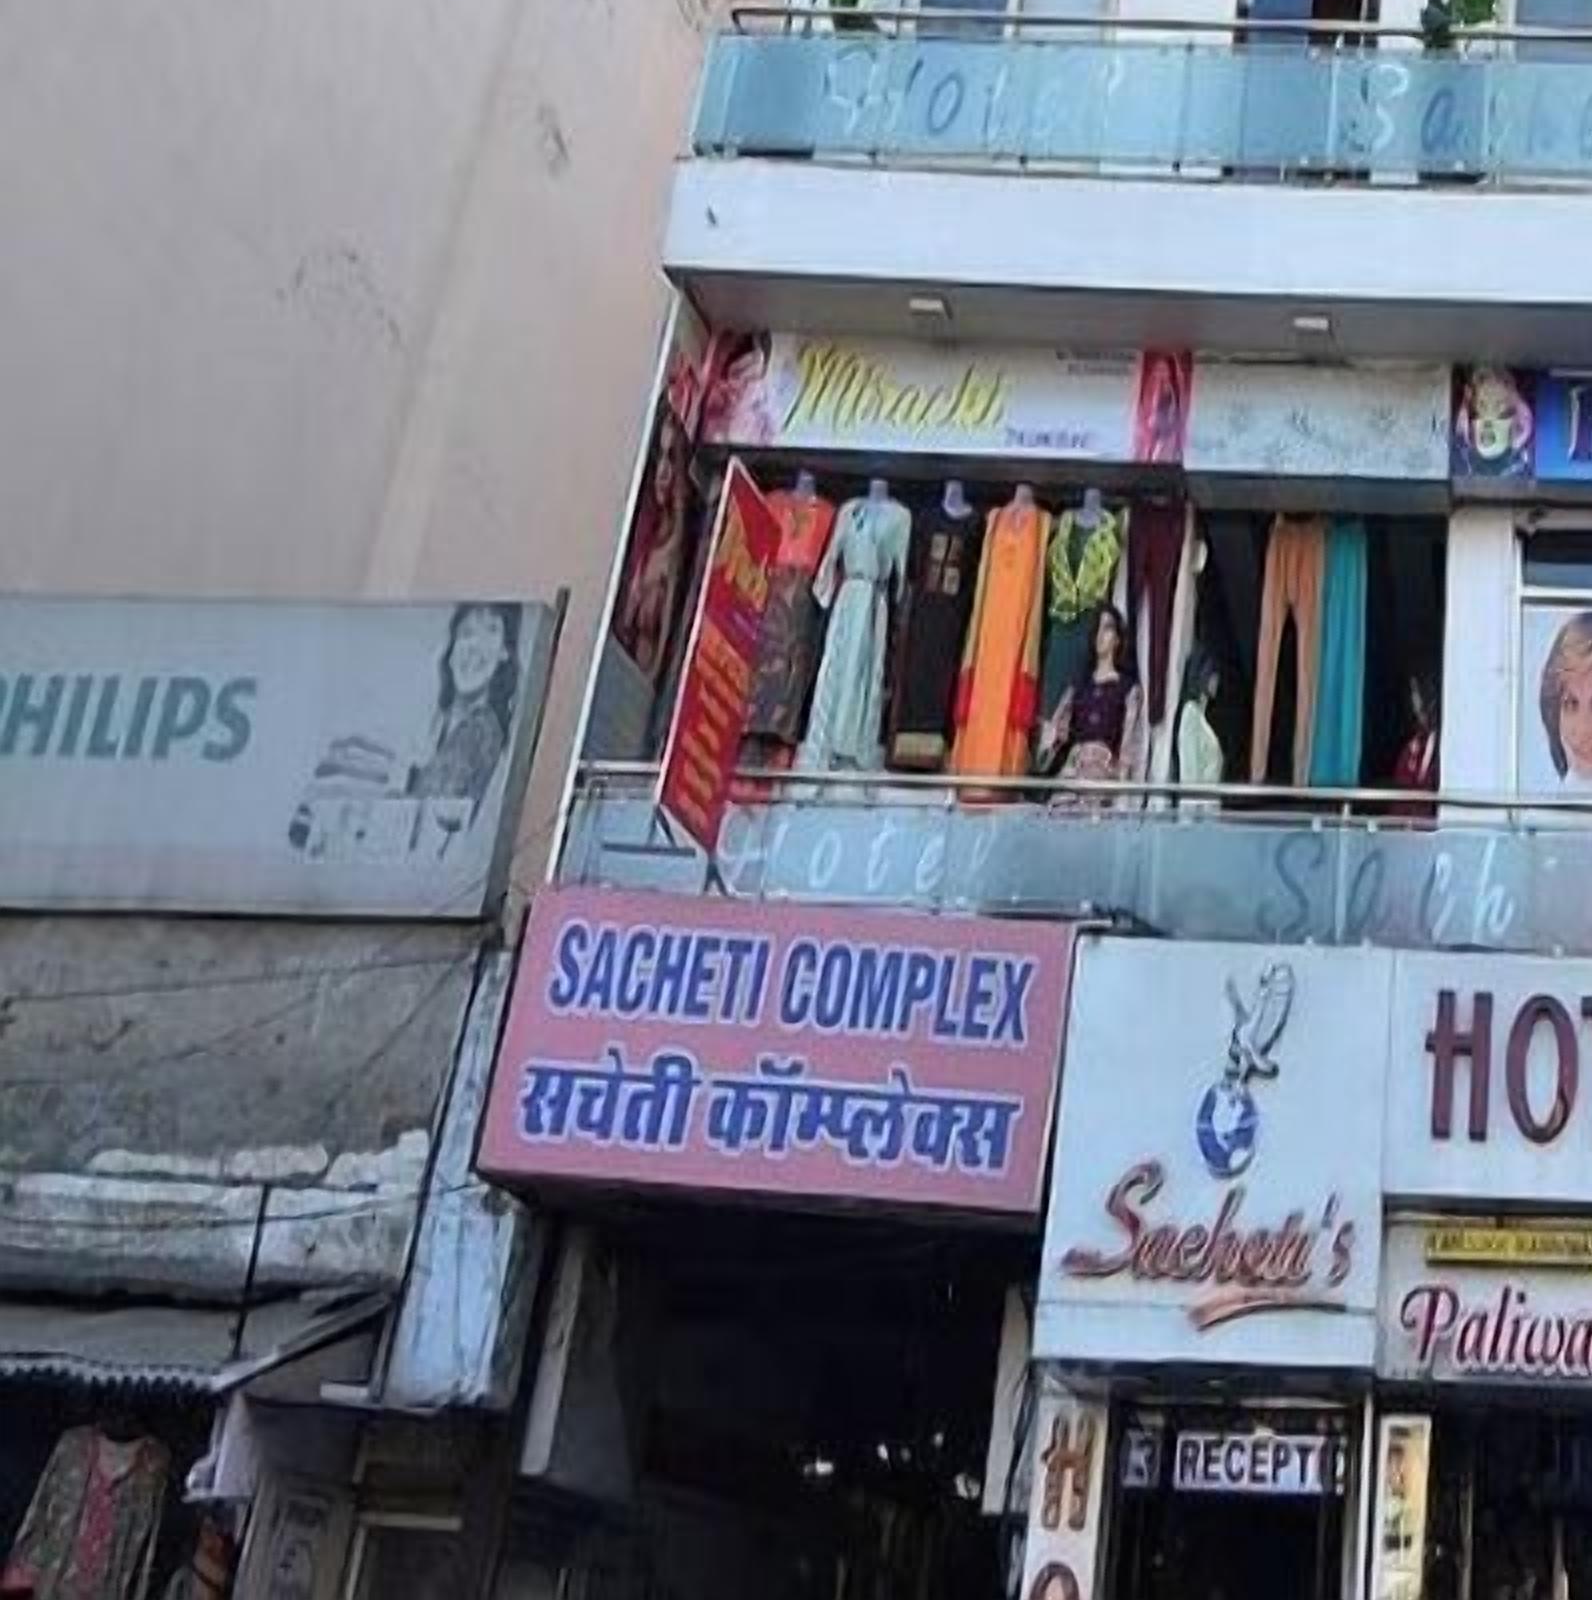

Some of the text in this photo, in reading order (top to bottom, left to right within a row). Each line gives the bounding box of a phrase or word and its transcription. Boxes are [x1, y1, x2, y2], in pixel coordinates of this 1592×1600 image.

[0, 673, 258, 761] HILIPS
[548, 923, 1034, 1043] SACHETI COMPLEX
[522, 1048, 702, 1146] सचेती
